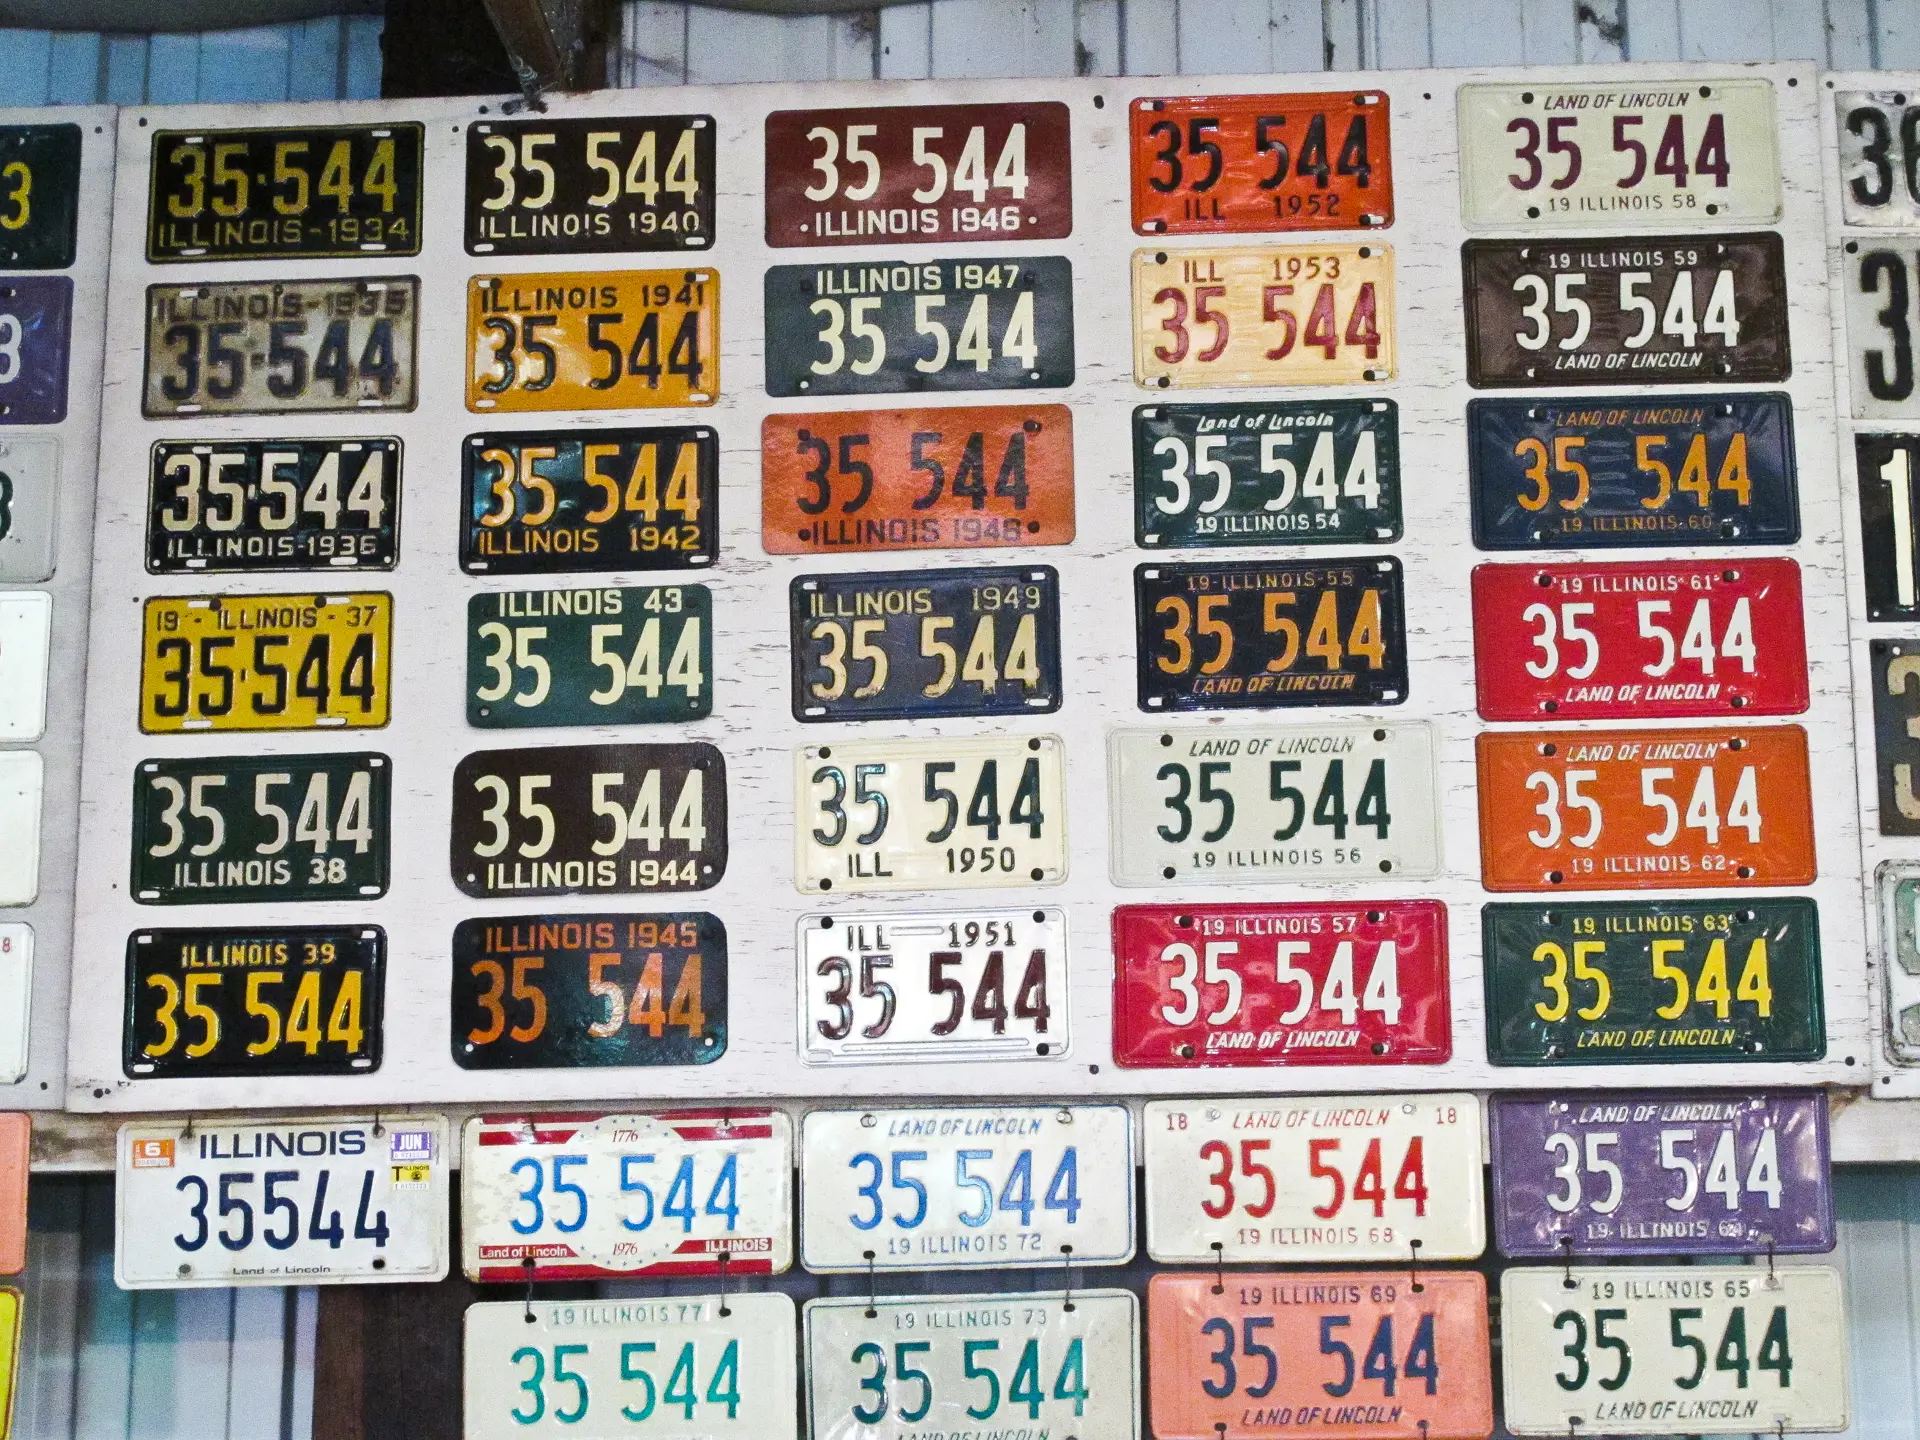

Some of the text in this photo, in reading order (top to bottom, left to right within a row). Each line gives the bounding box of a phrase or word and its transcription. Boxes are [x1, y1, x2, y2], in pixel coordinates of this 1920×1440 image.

[1544, 92, 1689, 110] LAND OF LINCOLN
[804, 123, 1029, 204] 35 544
[1506, 114, 1730, 191] 35 544
[482, 130, 699, 210] 35 544
[1184, 194, 1340, 220] ILL 1952
[1549, 194, 1696, 212] 19 ILLINOIS 58
[480, 210, 699, 238] ILLINOIS 1940
[815, 206, 1020, 236] ILLINOIS 1946
[1184, 256, 1340, 284] ILL 1953
[1549, 250, 1698, 269] 19 ILLINOIS 59
[817, 265, 1020, 294] ILLINOIS 1947
[482, 283, 704, 312] ILLINOIS 1941
[1512, 271, 1740, 351] 35 544
[1555, 352, 1702, 370] LAND OF LINCOLN
[1197, 414, 1334, 432] Land of Lincoln
[1152, 432, 1380, 515] 35 544
[1514, 432, 1751, 511] 35 544
[812, 519, 939, 545] ILLINOIS
[1196, 513, 1340, 534] 19 ILLINOIS 54
[479, 526, 700, 554] ILLINOIS 1942
[1561, 575, 1712, 594] 19 ILLINOIS 61
[499, 588, 682, 617] ILLINOIS 43
[810, 586, 1041, 616] ILLINOIS 1949
[218, 607, 317, 630] ILLINOIS
[1156, 589, 1386, 674] 35 544
[1522, 598, 1756, 680] 35 544
[476, 618, 703, 708] 35 544
[1565, 684, 1720, 702] LAND OF LINCOLN
[1190, 737, 1354, 757] LAND OF LINCOLN
[473, 769, 706, 858] 35 544
[812, 758, 1044, 846] 35 544
[1156, 759, 1391, 843] 35 544
[1525, 766, 1762, 848] 35 544
[848, 847, 1016, 878] ILL 1950
[1192, 848, 1361, 868] 19 ILLINOIS 56
[1571, 856, 1726, 872] 19 ILLINOIS 62
[175, 858, 346, 887] ILLINOIS 38
[488, 861, 697, 889] ILLINOIS 1944
[486, 922, 697, 953] ILLINOIS 1945
[848, 921, 1016, 951] ILL 1951
[1202, 917, 1357, 935] 19 ILLINOIS 57
[1573, 916, 1728, 934] 19 ILLINOIS 63
[182, 943, 335, 968] ILLINOIS 39
[144, 970, 363, 1058] 35 544
[1577, 1029, 1735, 1048] LAND OF LINCOLN
[1166, 1114, 1188, 1130] 18
[1233, 1109, 1390, 1130] LAND OF LINCOLN
[1436, 1108, 1457, 1124] 18
[200, 1130, 366, 1159] ILLINOIS
[400, 1134, 422, 1150] JUN
[612, 1130, 638, 1142] 1776
[1200, 1136, 1428, 1219] 35 544
[1544, 1130, 1782, 1214] 35 544
[510, 1154, 739, 1234] 35 544
[849, 1147, 1081, 1230] 35 544
[174, 1169, 390, 1251] 35544
[612, 1242, 638, 1255] 1976
[706, 1239, 769, 1252] ILLINOIS
[888, 1234, 1041, 1255] 19 ILLINOIS 72
[1239, 1228, 1393, 1244] 19 ILLINOIS 68
[480, 1246, 568, 1258] Land of Lincoln
[233, 1267, 264, 1275] Land
[285, 1266, 331, 1274] Lincoln
[1240, 1286, 1396, 1305] 19 ILLINOIS 69
[1592, 1280, 1750, 1299] 19 ILLINOIS 65
[1553, 1306, 1792, 1391] 35 544
[511, 1340, 740, 1424] 35 544
[1596, 1400, 1758, 1420] LAND OF LINCOLN
